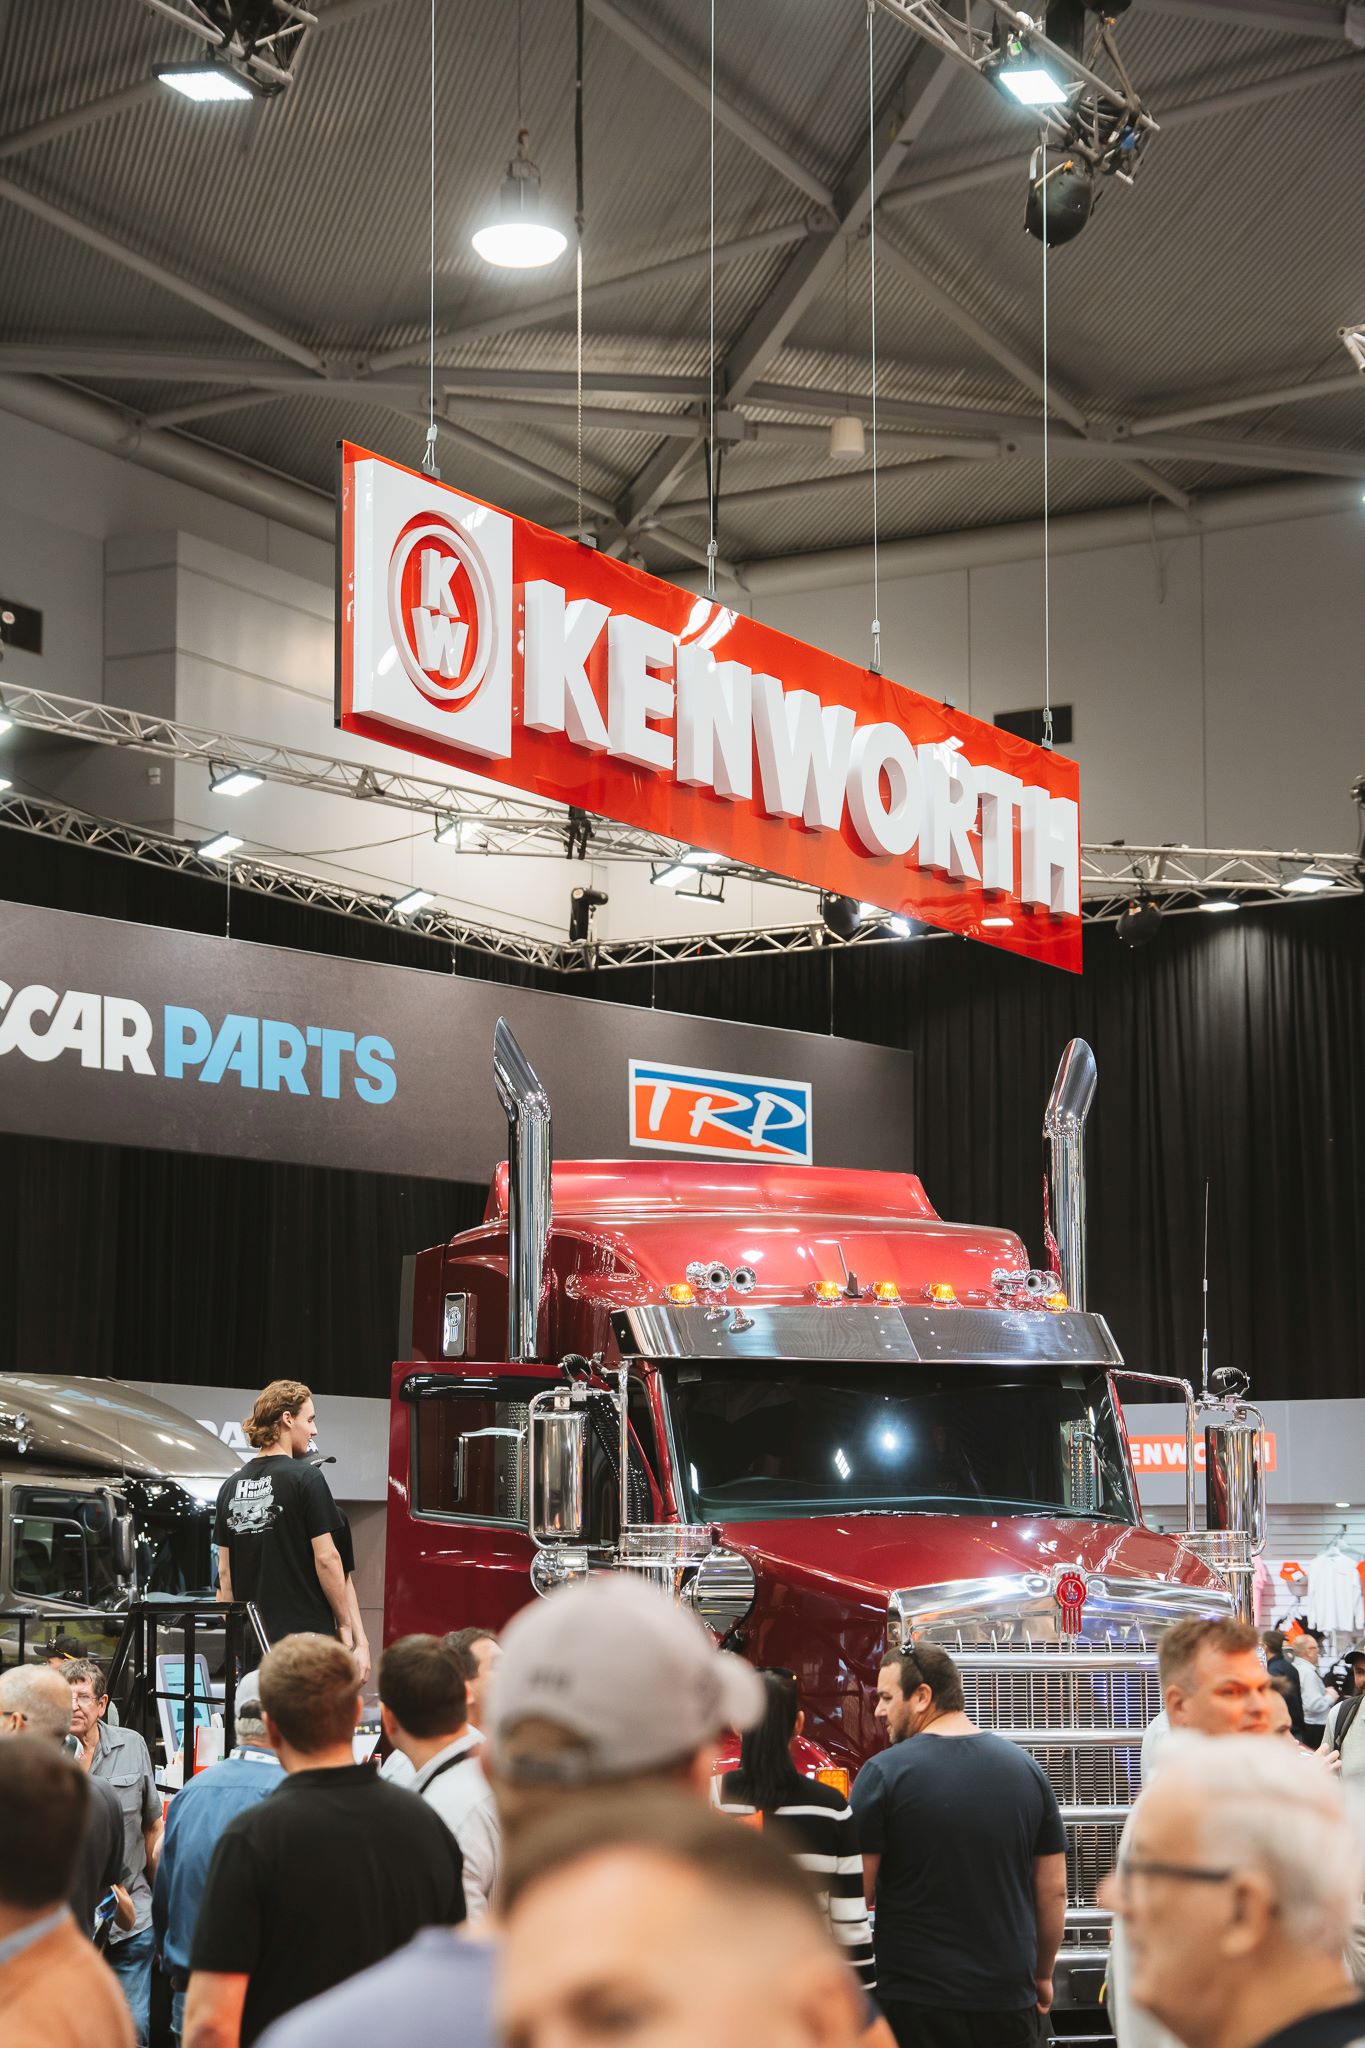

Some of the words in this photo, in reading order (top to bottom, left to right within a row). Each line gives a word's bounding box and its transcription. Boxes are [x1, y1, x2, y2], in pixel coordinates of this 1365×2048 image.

[523, 579, 1081, 916] KENWORTH
[0, 979, 157, 1076] CAR
[163, 1004, 398, 1105] PARTS
[635, 1077, 806, 1155] TRP
